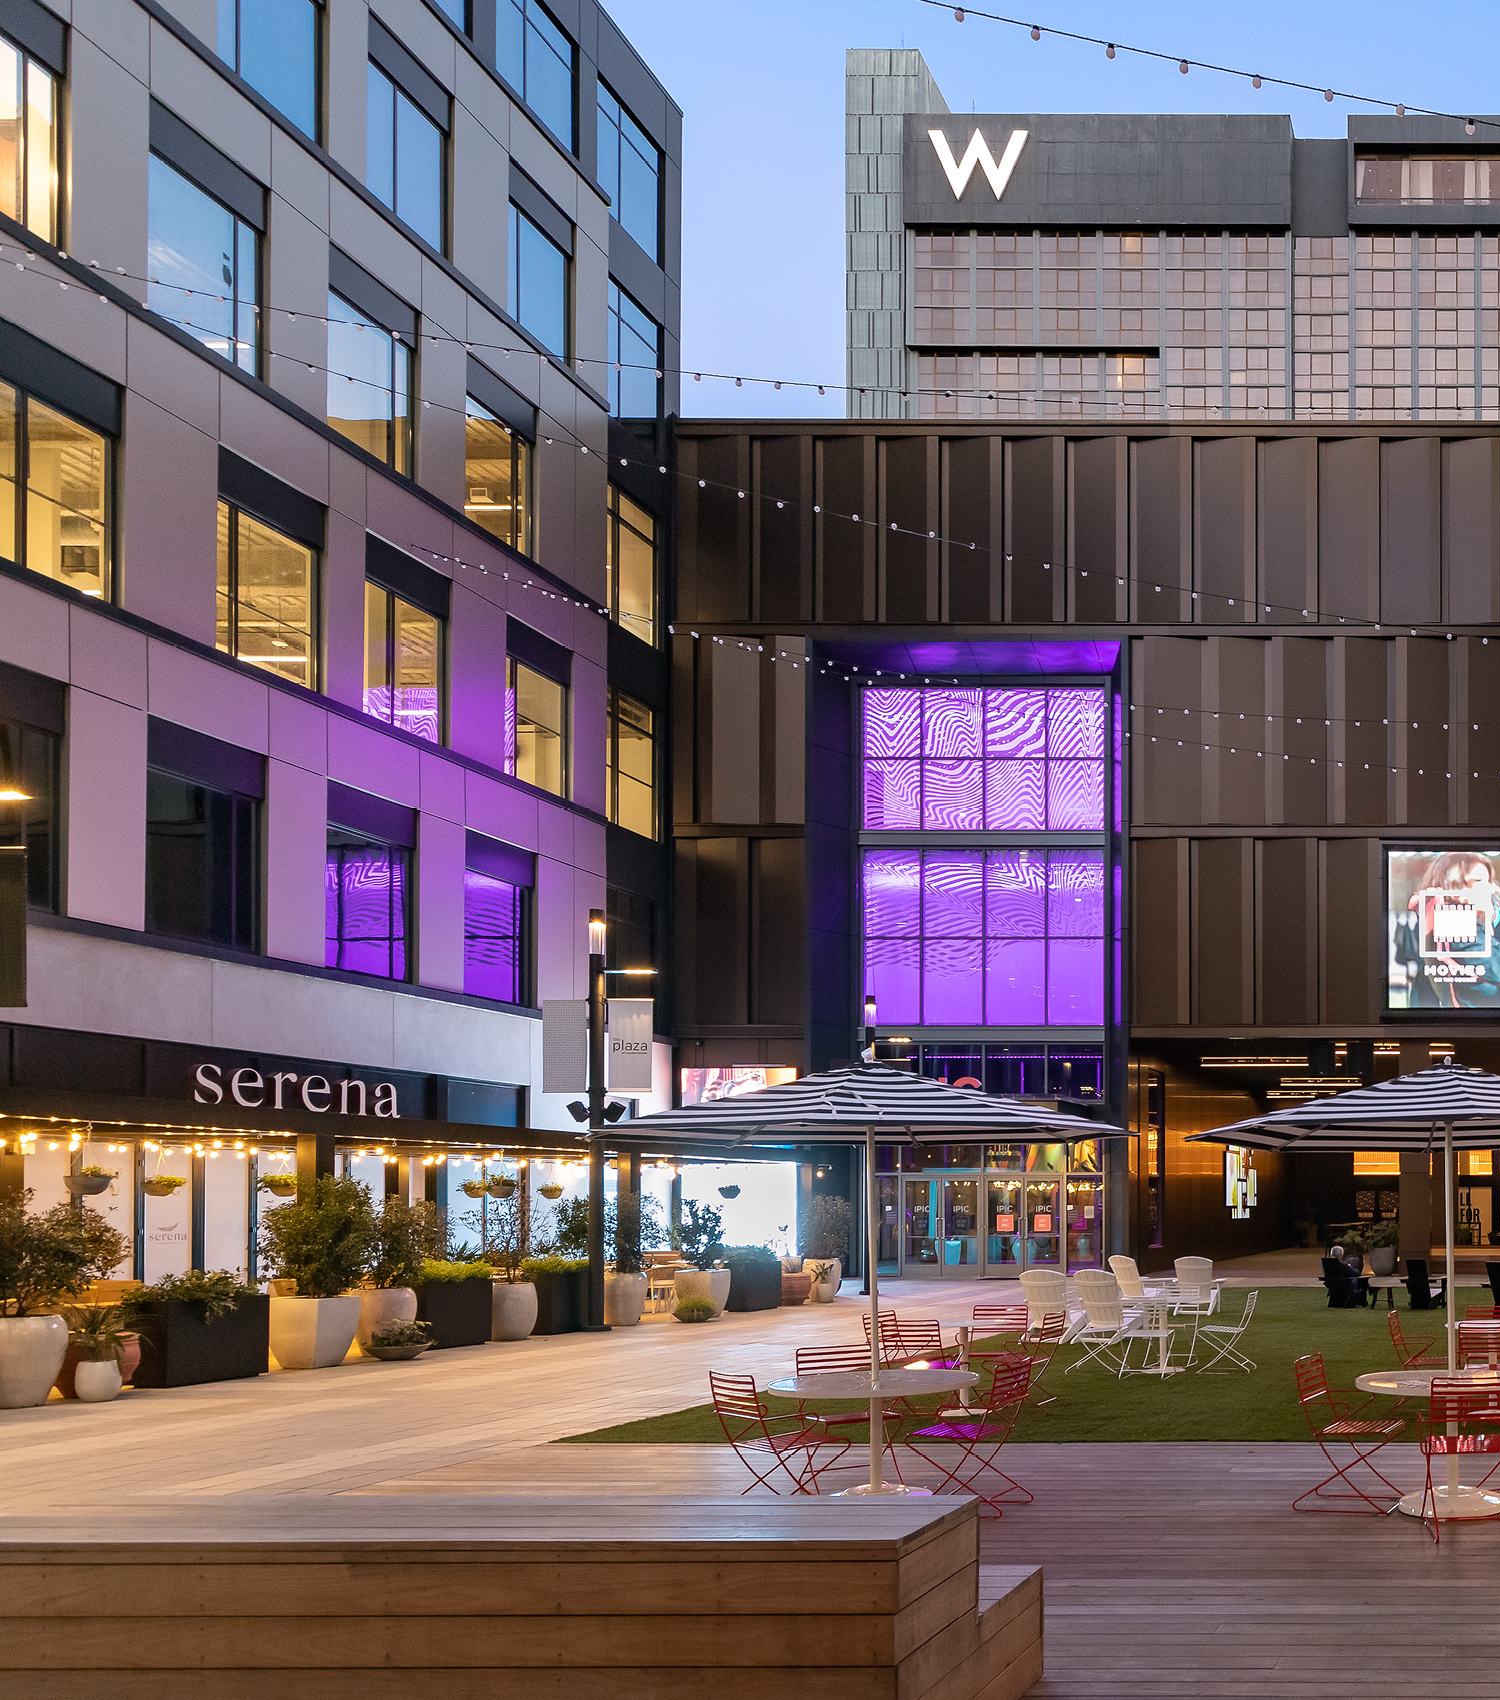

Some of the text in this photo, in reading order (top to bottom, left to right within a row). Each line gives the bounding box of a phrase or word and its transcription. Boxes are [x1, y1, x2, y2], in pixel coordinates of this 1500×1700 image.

[927, 127, 1029, 202] W
[1424, 965, 1486, 976] MOVIES
[612, 1040, 648, 1053] plaza
[194, 1063, 401, 1119] serena
[914, 1205, 930, 1213] IPIC
[953, 1205, 970, 1213] IPIC
[996, 1205, 1014, 1213] IPIC
[1035, 1205, 1052, 1213] IPIC
[1460, 1208, 1480, 1222] FOR
[148, 1233, 187, 1241] serena
